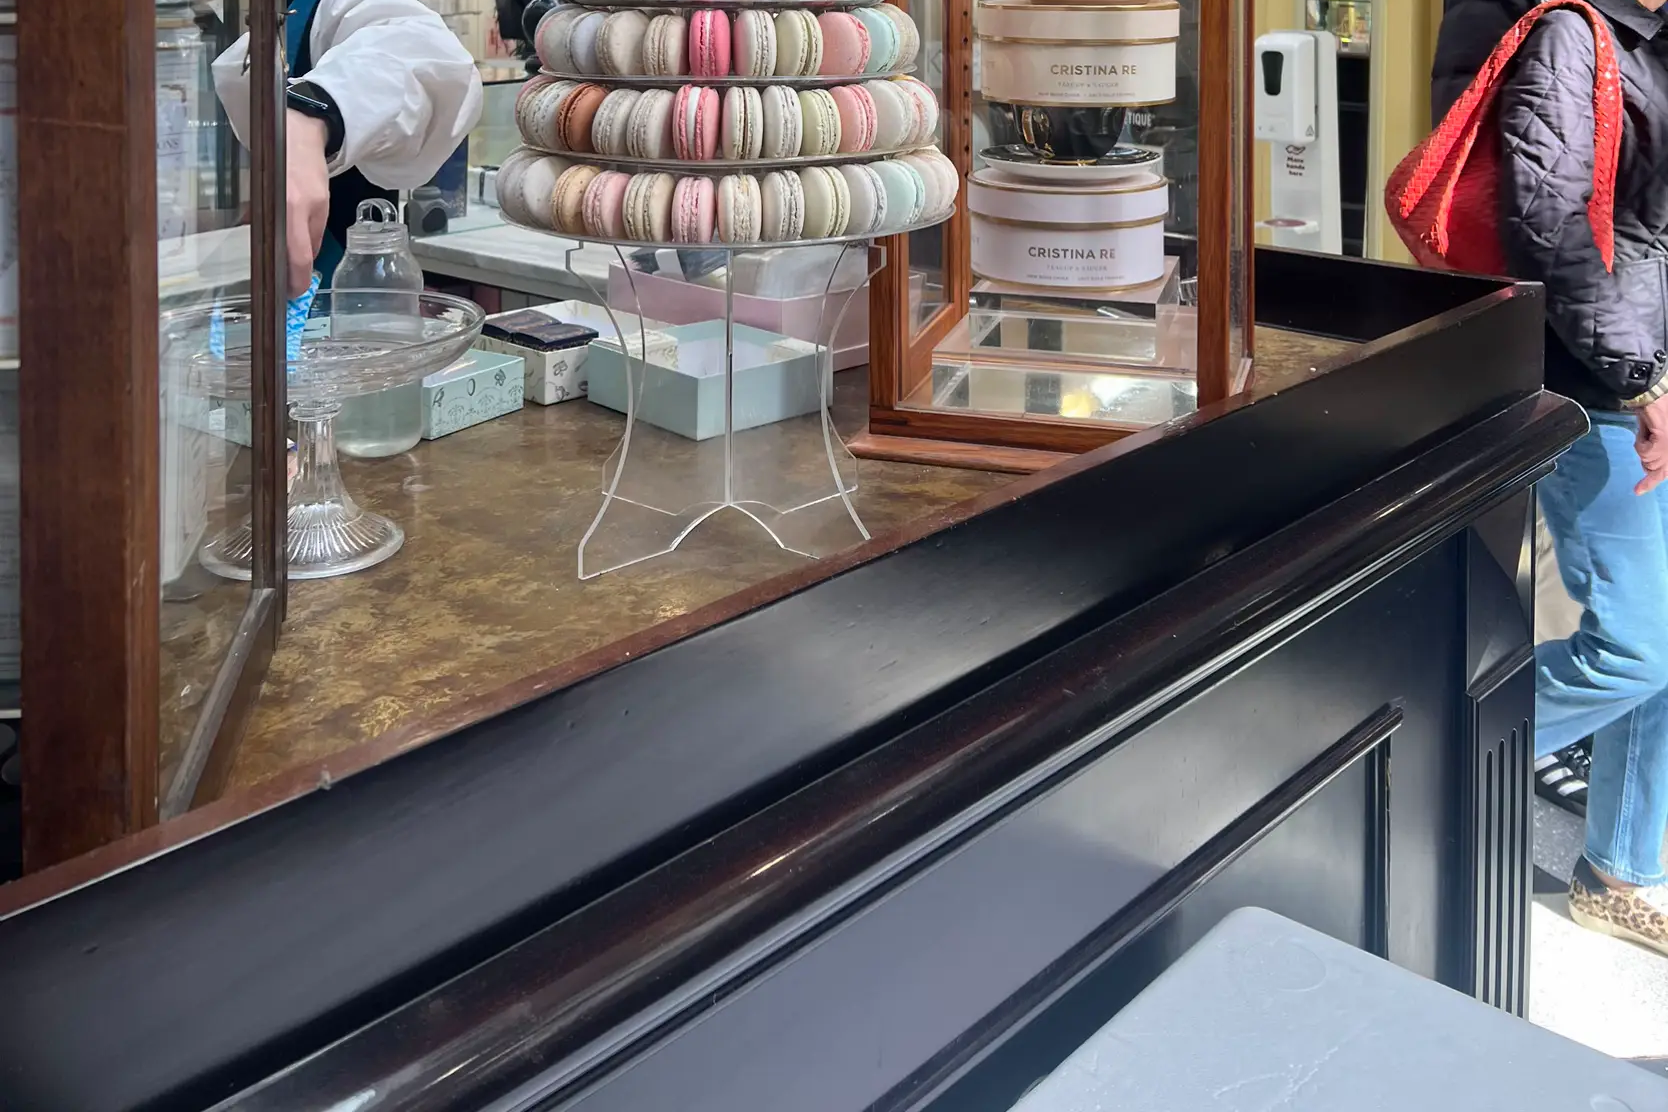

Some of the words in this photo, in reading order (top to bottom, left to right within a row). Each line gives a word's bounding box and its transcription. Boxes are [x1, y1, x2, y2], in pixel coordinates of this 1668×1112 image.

[1050, 64, 1118, 76] CRISTINA
[1121, 64, 1137, 75] RE
[1028, 246, 1096, 260] CRISTINA
[1099, 248, 1116, 260] RE
